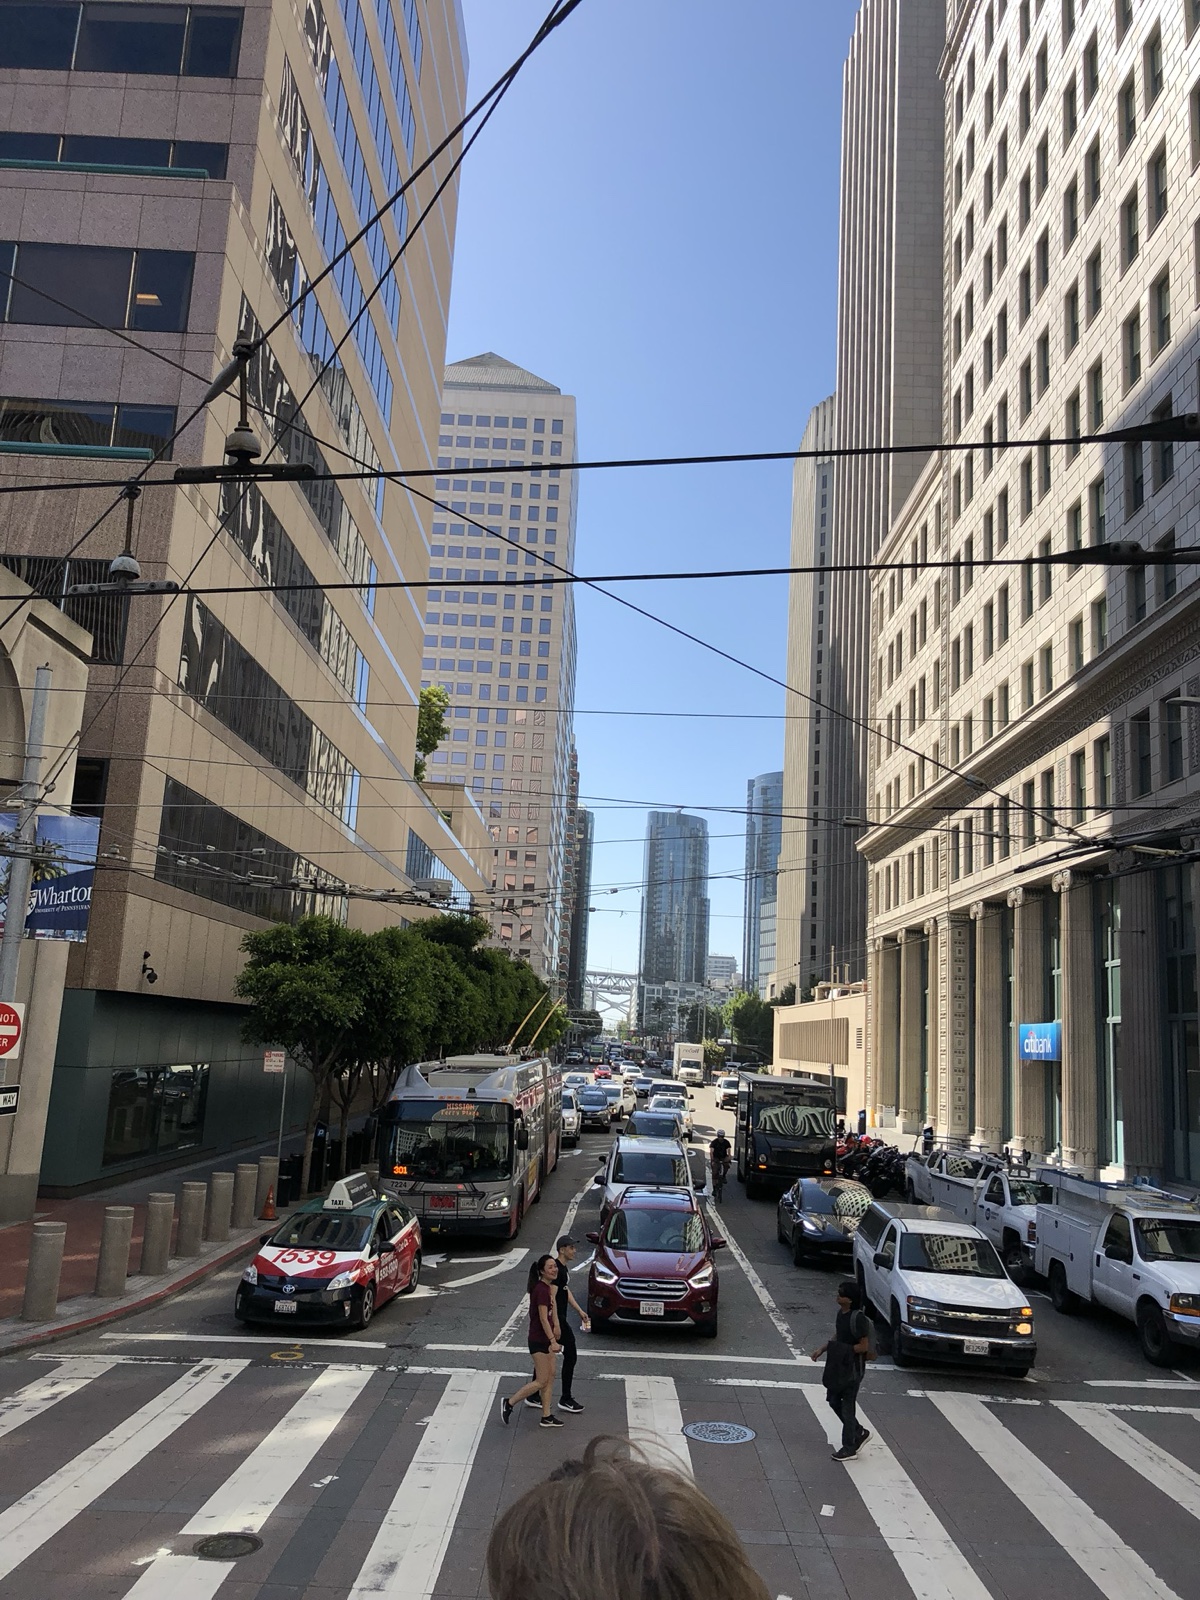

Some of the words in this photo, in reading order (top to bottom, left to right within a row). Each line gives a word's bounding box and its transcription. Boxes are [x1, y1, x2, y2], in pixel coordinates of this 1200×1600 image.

[1024, 1033, 1052, 1053] citibank
[3, 1094, 16, 1106] WAY
[393, 1166, 408, 1174] 301
[271, 1248, 337, 1267] 1539
